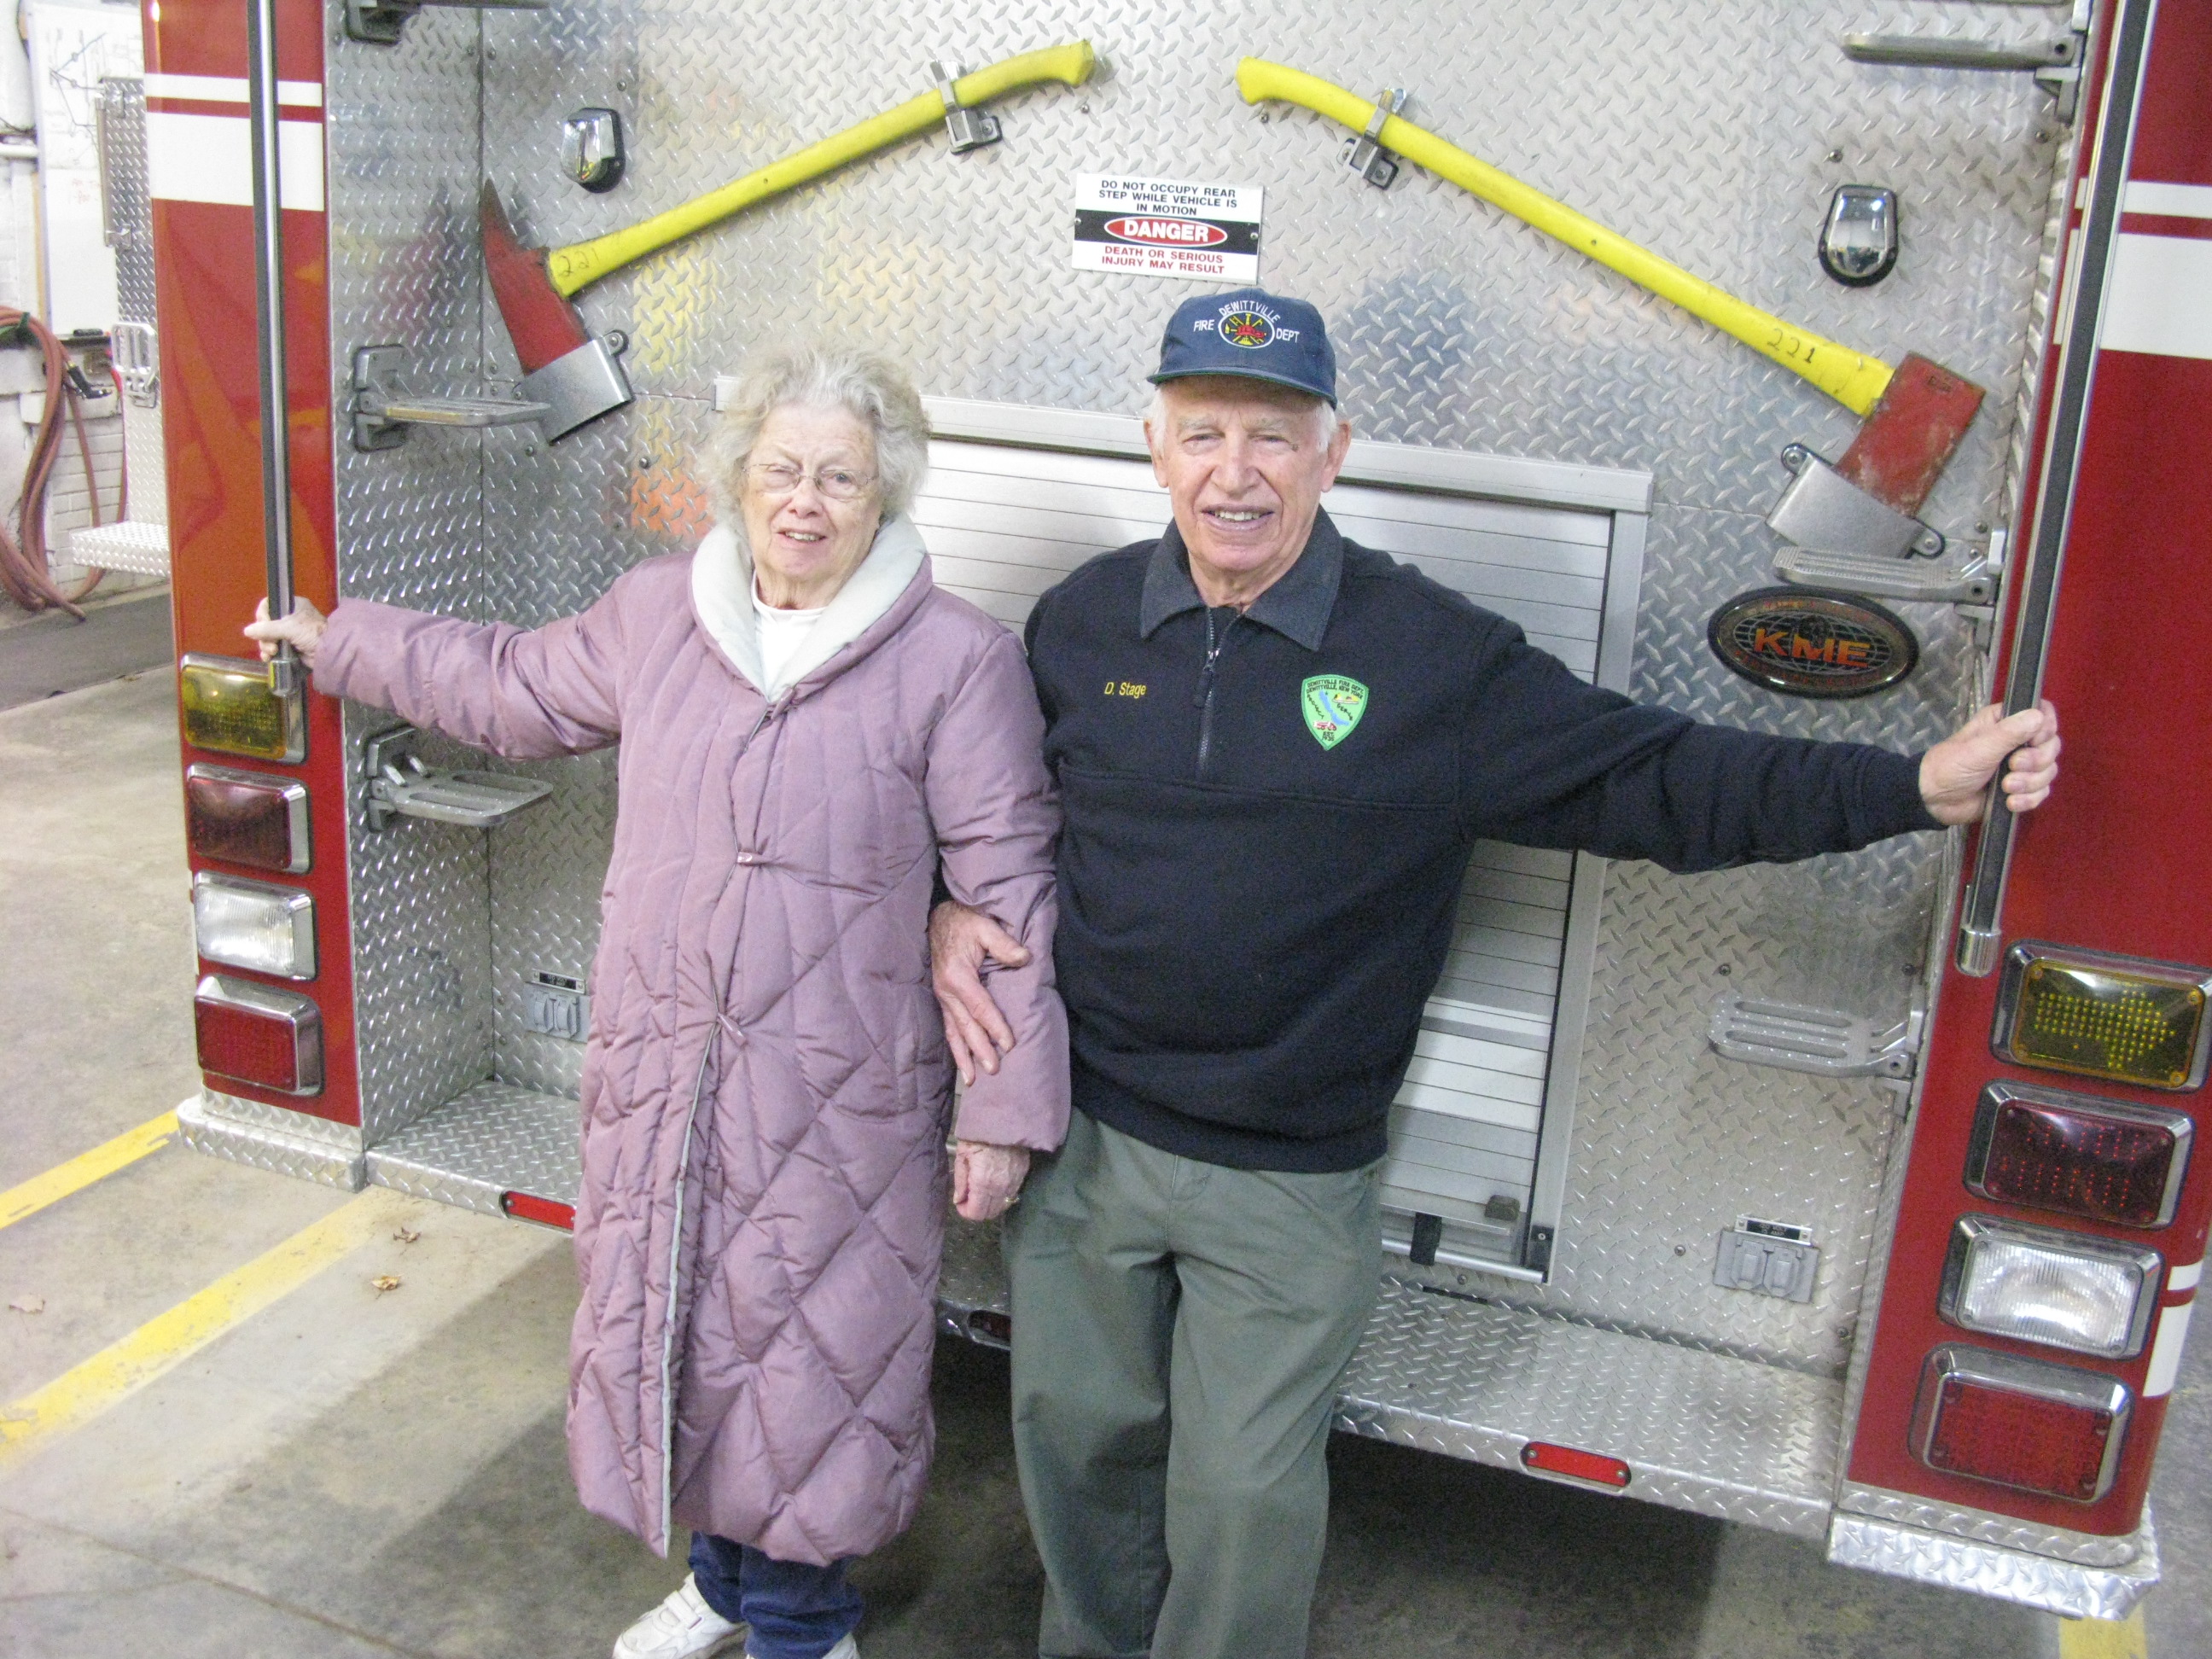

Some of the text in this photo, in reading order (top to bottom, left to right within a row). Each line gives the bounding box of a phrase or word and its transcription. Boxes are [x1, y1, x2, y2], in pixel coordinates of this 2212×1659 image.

[1101, 180, 1236, 198] DO NOT OCCUPY REAR
[1099, 189, 1237, 208] STEP WHILE VEHICLE IS
[1137, 203, 1197, 215] IN MOTION
[1124, 219, 1209, 242] DANGER
[558, 247, 599, 278] 221
[1105, 246, 1223, 263] DEATH OR SERIOUS
[1102, 256, 1225, 274] INJURY MAY RESULT
[1219, 300, 1280, 323] DEWITTVILLE
[1193, 319, 1300, 343] FIRE DEPT
[1767, 328, 1815, 364] 221
[1753, 628, 1871, 668] KME
[1104, 682, 1147, 699] D. Stage
[1307, 679, 1337, 687] DEWITTVILLE
[1350, 690, 1364, 700] YORK
